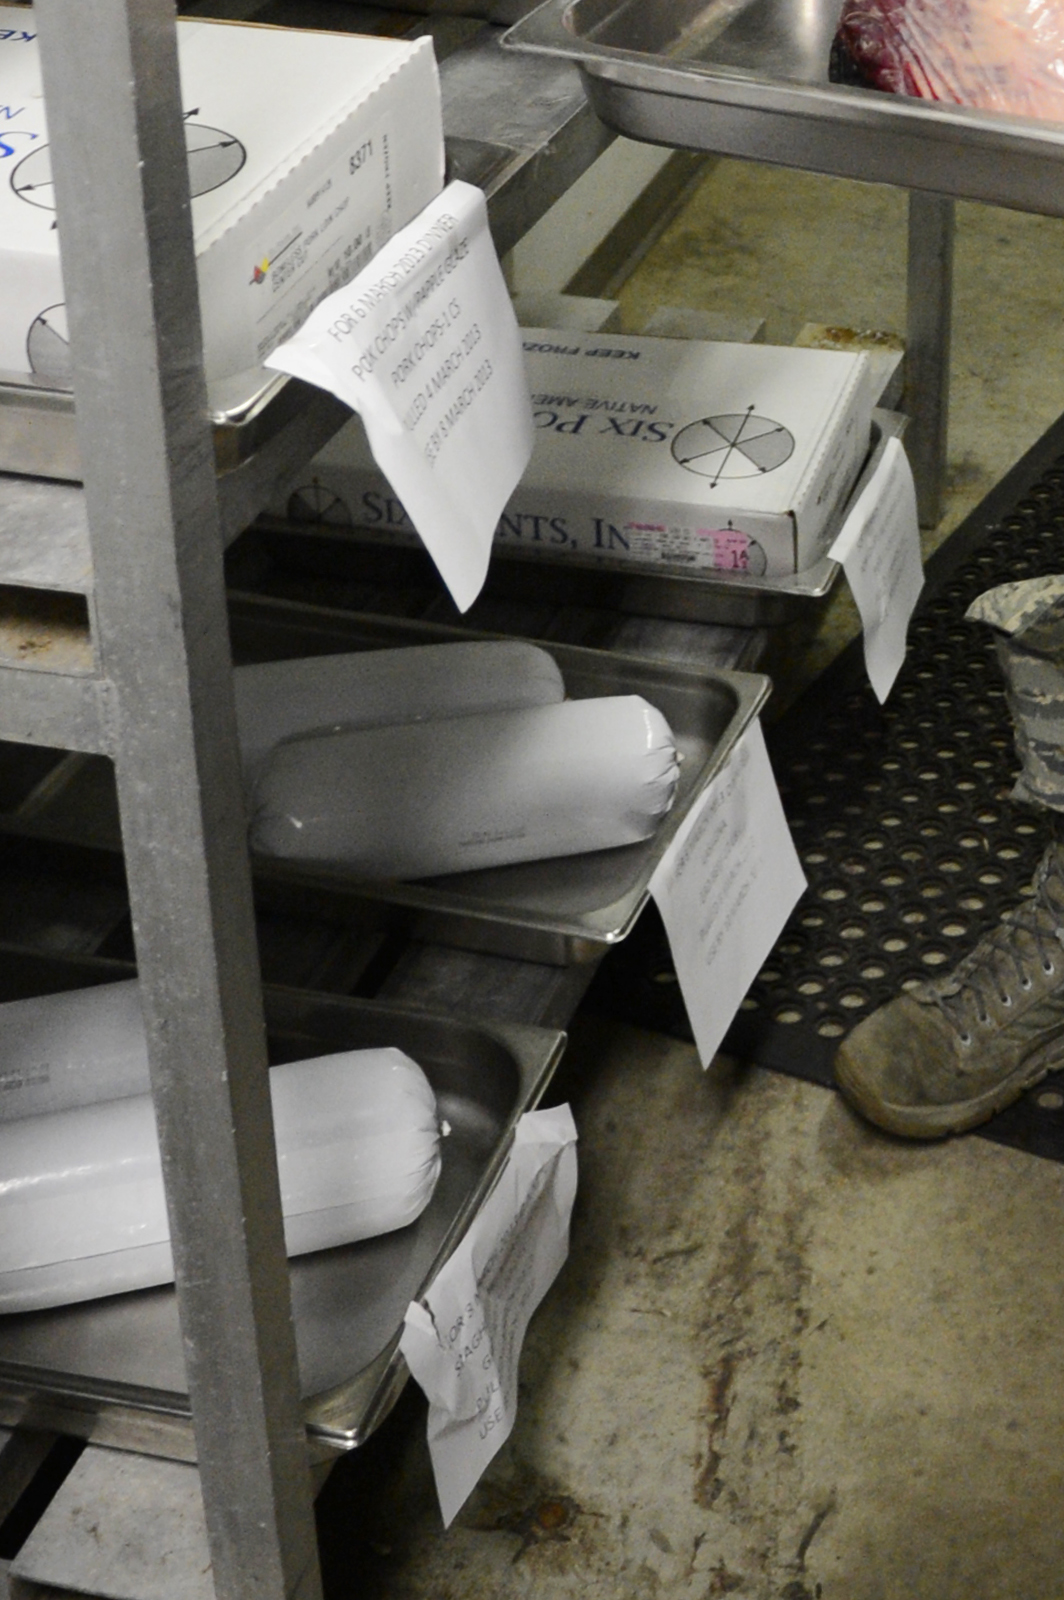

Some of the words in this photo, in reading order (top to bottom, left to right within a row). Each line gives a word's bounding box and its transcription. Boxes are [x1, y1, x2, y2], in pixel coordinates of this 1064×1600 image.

[327, 312, 359, 343] FOR
[356, 271, 405, 312] MARCH
[392, 246, 426, 275] 2013
[584, 347, 641, 361] KEEP
[431, 346, 465, 394] MARCH
[584, 397, 658, 416] NATIVE
[599, 416, 675, 443] SIX
